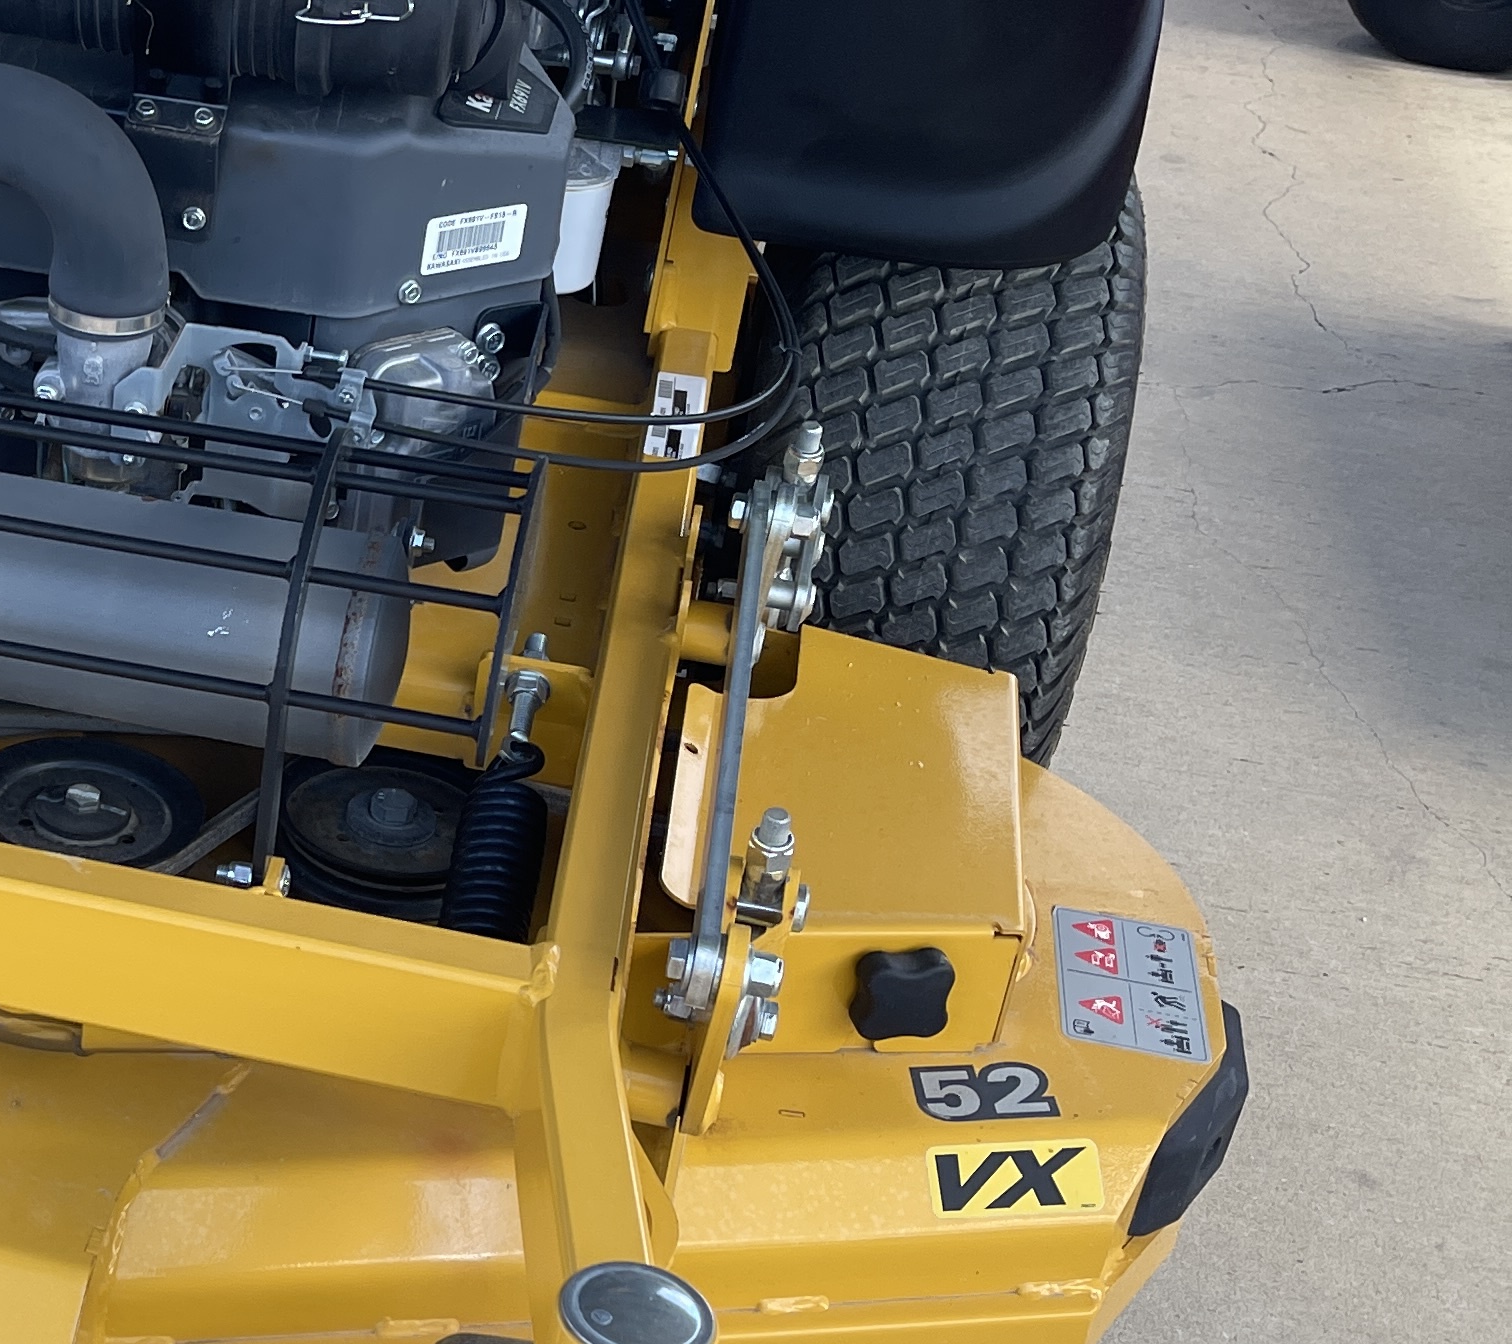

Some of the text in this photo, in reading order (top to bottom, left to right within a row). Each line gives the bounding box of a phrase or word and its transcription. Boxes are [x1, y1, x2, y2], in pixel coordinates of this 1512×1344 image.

[509, 78, 532, 115] FX691V
[918, 1065, 1051, 1117] 52
[934, 1146, 1087, 1212] VX
